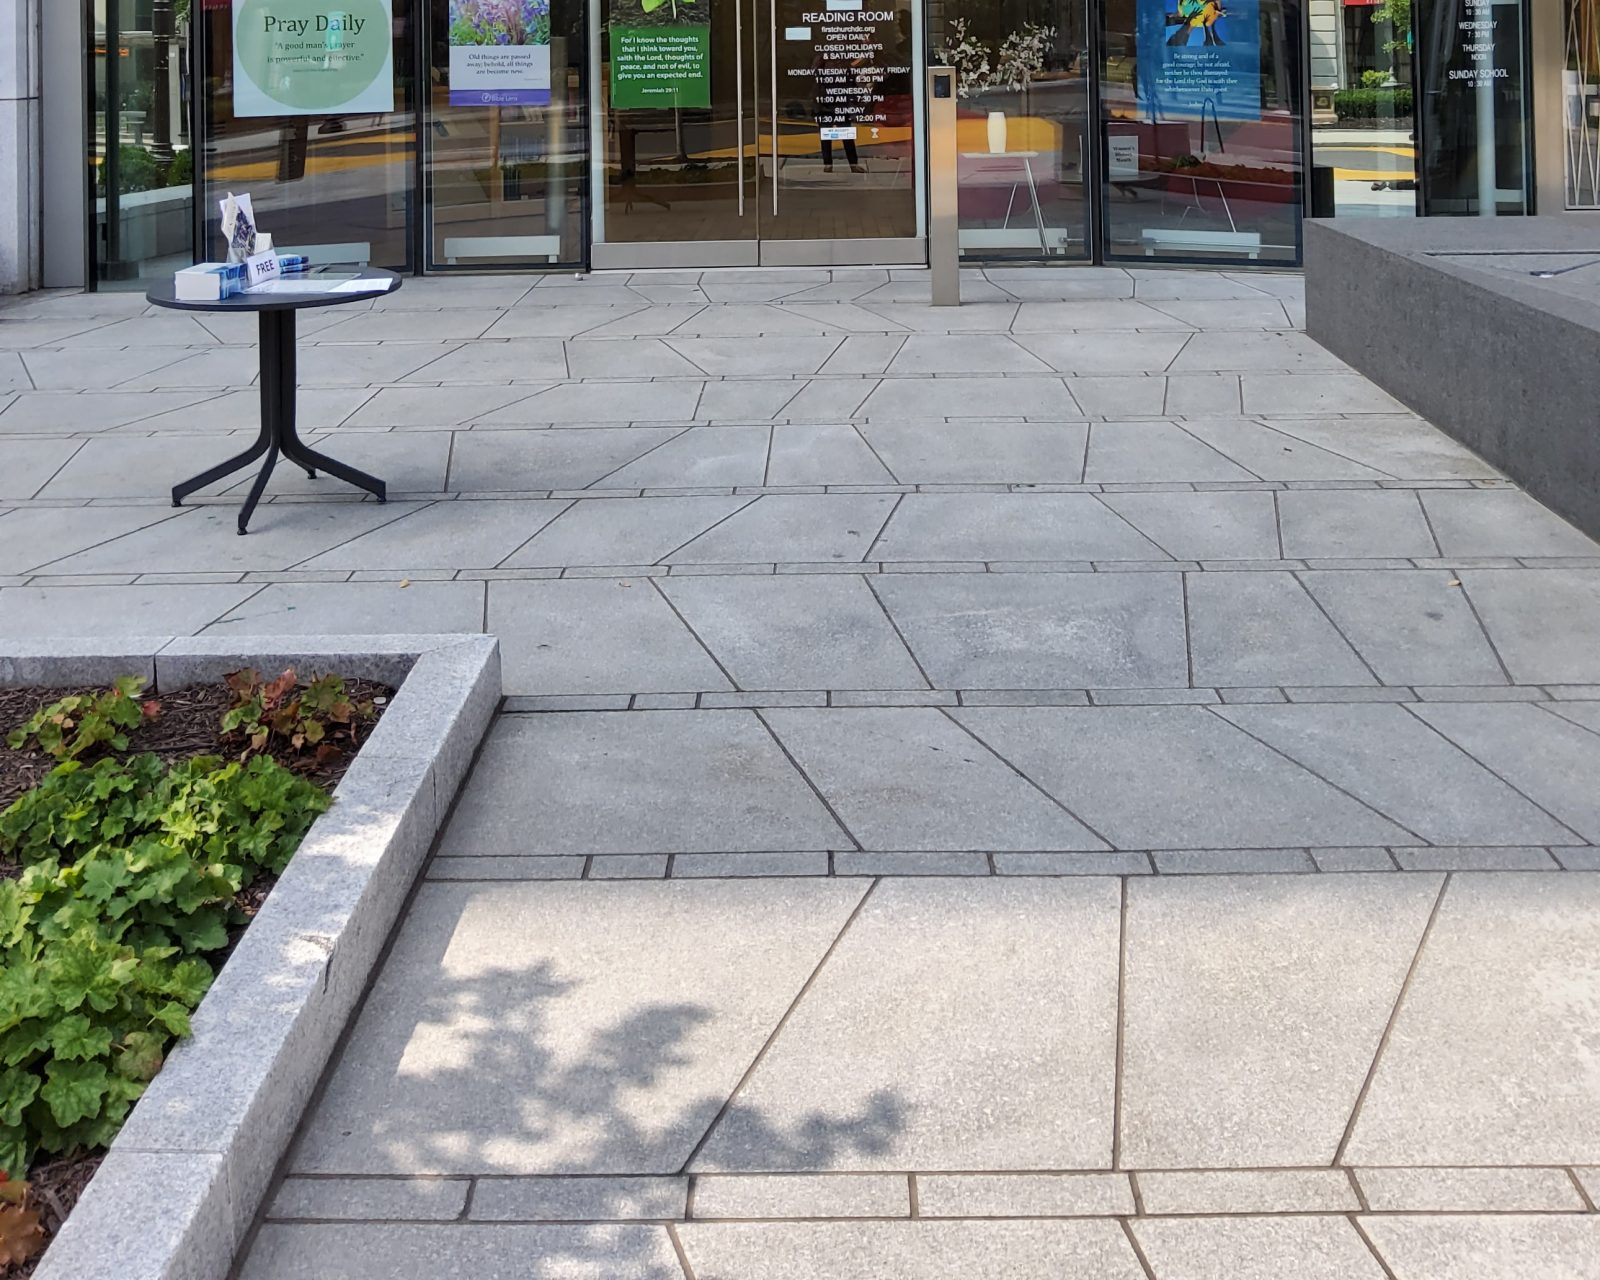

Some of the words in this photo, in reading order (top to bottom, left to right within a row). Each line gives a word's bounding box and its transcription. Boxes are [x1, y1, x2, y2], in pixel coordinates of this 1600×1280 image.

[1465, 0, 1490, 7] SUNDAY
[802, 12, 855, 23] READING
[858, 11, 894, 22] ROOM
[264, 15, 310, 37] Pray
[315, 14, 366, 35] Daily
[821, 25, 875, 33] firstchurchdc.org
[1458, 21, 1498, 30] WEDNESDAY
[668, 36, 699, 44] thoughts
[826, 33, 847, 41] OPEN
[848, 33, 870, 41] DAILY
[285, 42, 304, 51] good
[814, 44, 844, 52] CLOSED
[846, 43, 883, 51] HOLIDAYS
[1462, 44, 1495, 52] THURSDAY
[275, 55, 310, 64] powerful
[664, 54, 695, 62] thoughts
[830, 52, 875, 60] SATURDAYS
[677, 62, 692, 70] evil,
[617, 72, 632, 80] give
[656, 71, 687, 80] expected
[787, 69, 817, 77] MONDAY,
[818, 68, 849, 76] TUESDAY,
[1448, 69, 1478, 80] SUNDAY
[1479, 69, 1509, 78] SCHOOL
[815, 76, 834, 84] 11:00
[826, 87, 873, 95] WEDNESDAY
[833, 115, 846, 123] AM
[256, 259, 275, 275] FREE
